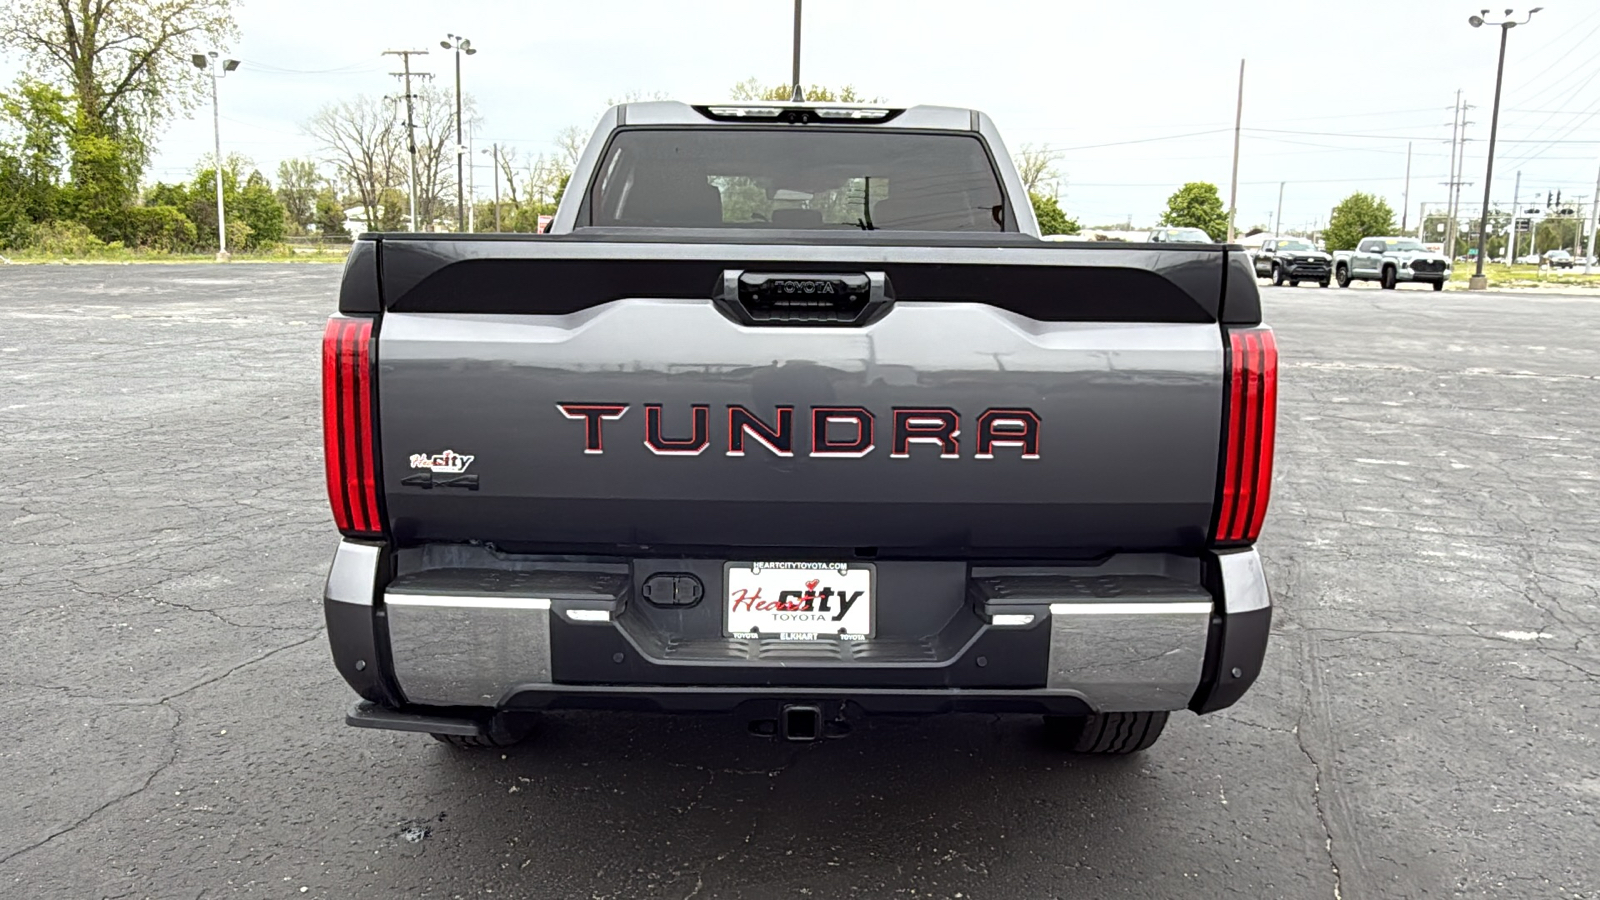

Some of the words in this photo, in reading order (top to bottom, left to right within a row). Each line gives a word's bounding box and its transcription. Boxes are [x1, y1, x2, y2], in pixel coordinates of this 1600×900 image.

[775, 281, 834, 294] TOYOTA
[555, 402, 1042, 460] TUNDRA
[753, 562, 847, 570] HEARTCITYTOYOTA.COM
[731, 587, 826, 612] Heart
[777, 579, 865, 622] city
[772, 613, 826, 622] TOYOTA
[780, 632, 818, 640] ELKHART
[840, 633, 865, 641] TOYOTA
